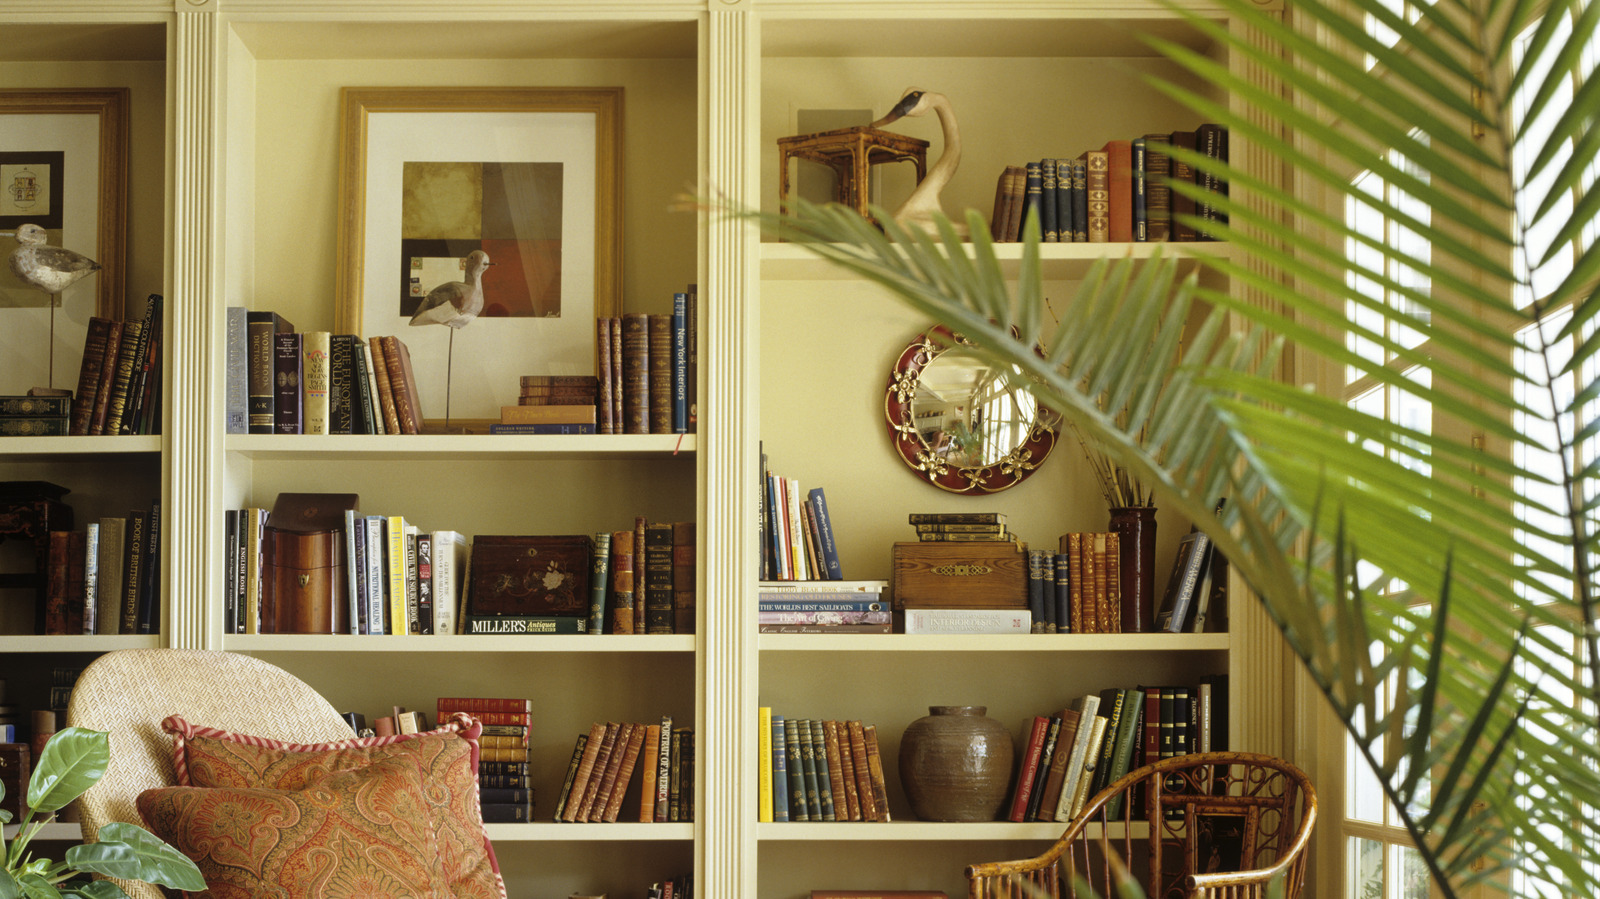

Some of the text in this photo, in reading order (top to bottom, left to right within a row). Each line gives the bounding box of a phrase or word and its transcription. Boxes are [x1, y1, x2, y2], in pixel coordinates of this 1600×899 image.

[135, 330, 148, 371] COUNTRYSIDE
[230, 317, 239, 344] WAR
[230, 350, 239, 378] CIVIL
[333, 342, 342, 386] WORLD
[342, 343, 350, 364] THE
[341, 368, 351, 429] EUROPEAN
[87, 527, 96, 568] Birdwatch
[128, 518, 142, 613] BOOK OF BRITISH BIRDS
[392, 531, 401, 609] HEALTHY HEALING
[472, 620, 526, 632] MILLER'S
[1111, 693, 1124, 728] LORD'S
[659, 722, 671, 802] PORTRAIT OF AMERICA
[1119, 737, 1128, 763] WORLD
